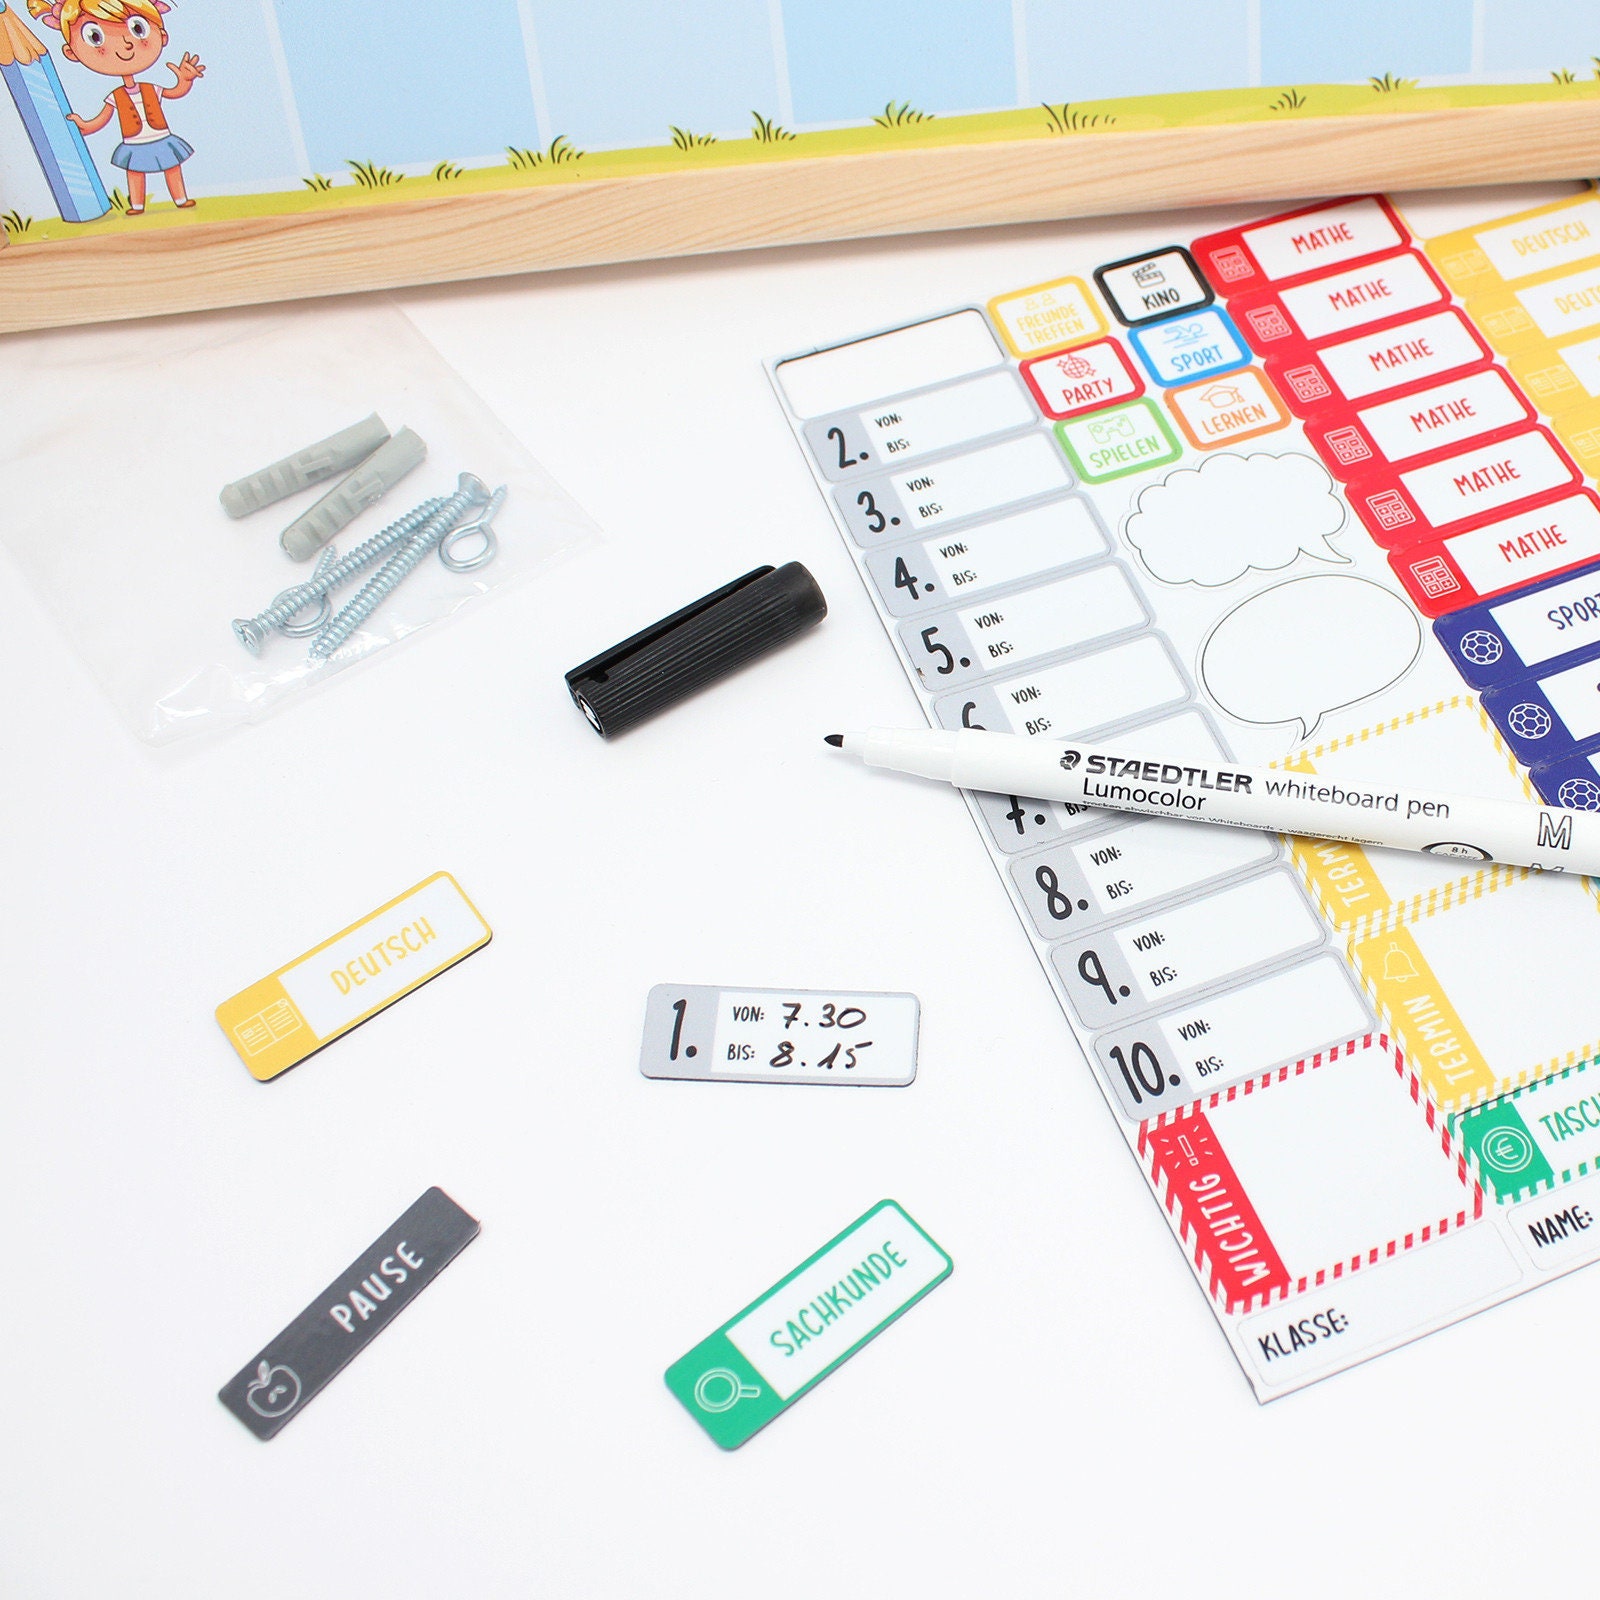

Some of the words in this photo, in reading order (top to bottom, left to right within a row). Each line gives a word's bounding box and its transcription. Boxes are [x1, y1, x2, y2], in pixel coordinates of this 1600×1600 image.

[1292, 223, 1353, 255] MATHE
[1512, 221, 1590, 257] DEUTSCH
[1142, 288, 1180, 310] KINO
[1328, 278, 1392, 311] MATHE
[1017, 303, 1078, 332] FREUNDE
[1025, 319, 1084, 345] TREFFEN
[1171, 345, 1224, 372] SPORT
[1369, 338, 1433, 371] MATHE
[1063, 377, 1113, 405] PARTY
[875, 413, 902, 428] VON:
[1201, 404, 1266, 435] LERNEN
[1410, 398, 1476, 433] MATHE
[828, 427, 869, 469] 2.
[887, 438, 910, 453] BIS:
[1090, 437, 1159, 469] SPIELEN
[906, 477, 934, 492] VON:
[1453, 460, 1521, 496] MATHE
[857, 491, 900, 533] 3.
[919, 503, 942, 518] BIS:
[939, 543, 968, 559] VON:
[1498, 524, 1567, 563] MATHE
[894, 557, 935, 601] 4.
[952, 570, 977, 586] BIS:
[974, 612, 1004, 629] VON:
[920, 627, 970, 674] 5.
[988, 642, 1013, 658] BIS:
[1011, 687, 1041, 704] VON:
[1026, 718, 1051, 736] BIS:
[1083, 778, 1207, 810] Lumocolor
[1086, 755, 1253, 794] STAEDTLER
[1266, 779, 1398, 811] whiteboard
[1407, 800, 1449, 819] pen
[1082, 801, 1122, 809] trocken
[1209, 818, 1274, 830] Whiteboards
[1288, 828, 1348, 840] waagerecht
[1537, 812, 1572, 850] M
[1090, 846, 1122, 866] VON:
[1310, 837, 1370, 908] TERMI
[1035, 866, 1088, 920] 8.
[1106, 880, 1133, 899] BIS:
[330, 916, 436, 996] DEUTSCH
[1133, 931, 1165, 952] VON:
[1078, 950, 1131, 1005] 9.
[1149, 967, 1178, 986] BIS:
[670, 999, 697, 1060] 1.
[733, 1006, 764, 1022] VON:
[782, 1003, 866, 1029] 7.30
[1177, 1019, 1210, 1041] VON:
[727, 1044, 755, 1060] BIS:
[1403, 994, 1475, 1085] TERMIN
[1109, 1041, 1180, 1104] 10.
[1195, 1056, 1224, 1076] BIS:
[1189, 1173, 1271, 1287] WICHTIG
[1527, 1205, 1593, 1248] NAME:
[329, 1239, 425, 1335] PAUSE
[769, 1239, 908, 1358] SACHKUNDE
[1258, 1308, 1349, 1362] KLASSE:
